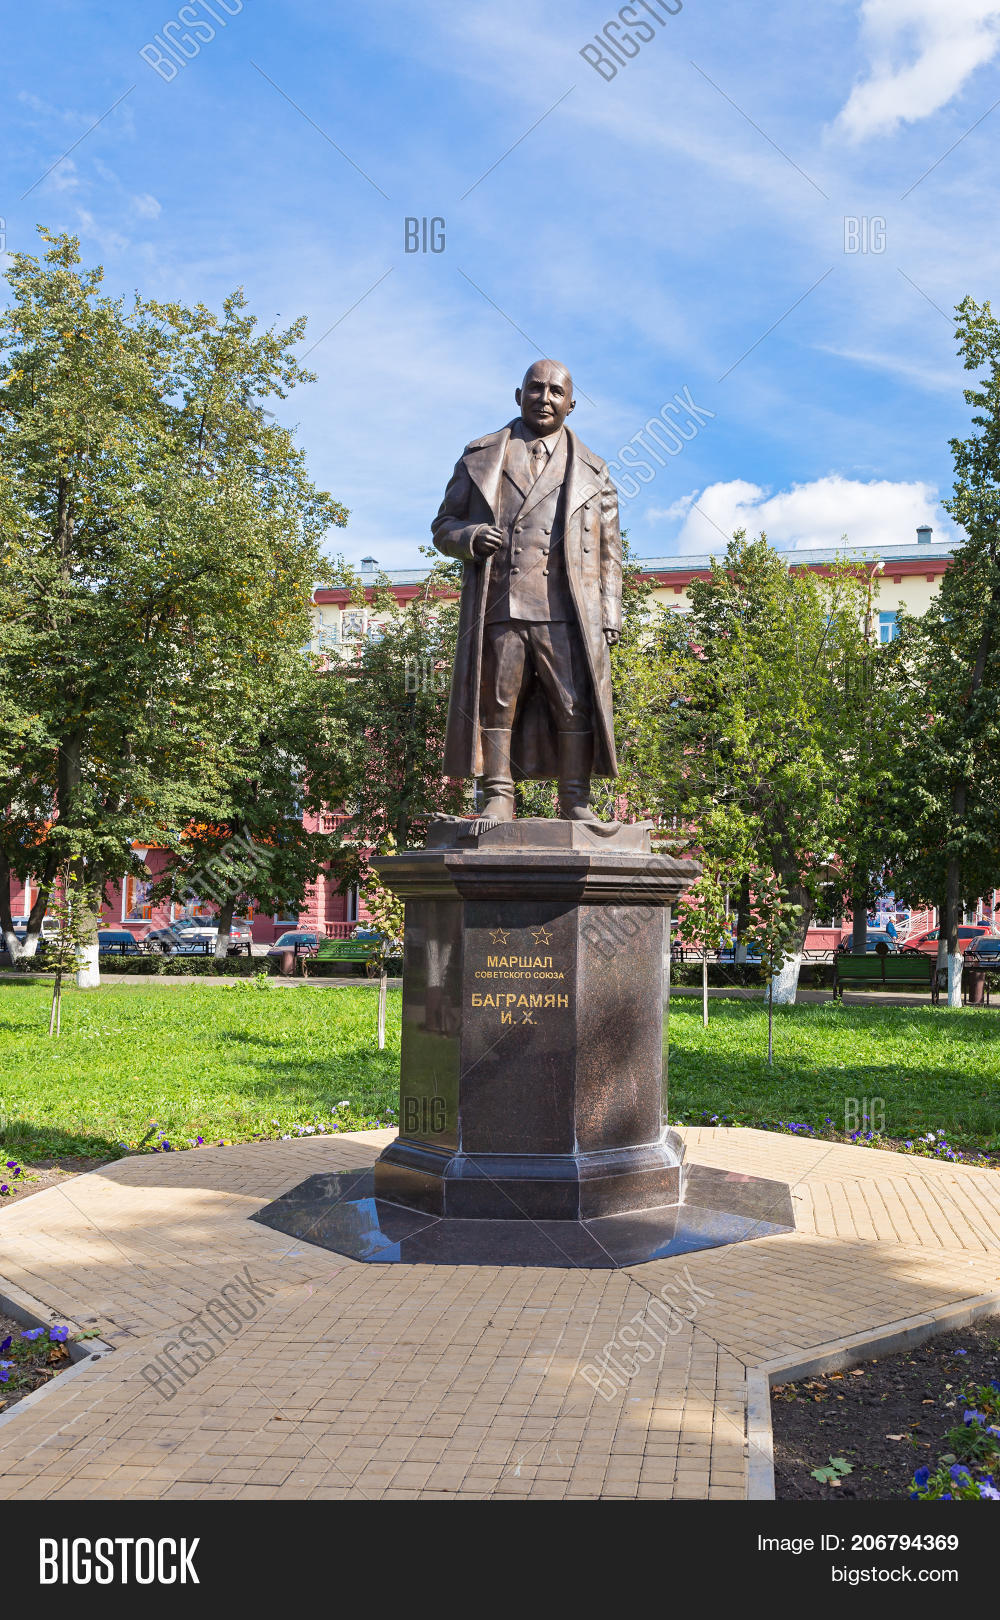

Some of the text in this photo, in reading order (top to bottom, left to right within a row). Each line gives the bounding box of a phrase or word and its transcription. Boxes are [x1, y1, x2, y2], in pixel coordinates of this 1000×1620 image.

[487, 955, 553, 968] МАРШАЛ
[475, 971, 565, 979] СОВЕТСКОГО СОЮЗА
[471, 993, 569, 1008] БАГРАМЯН
[500, 1010, 538, 1025] И. Х.
